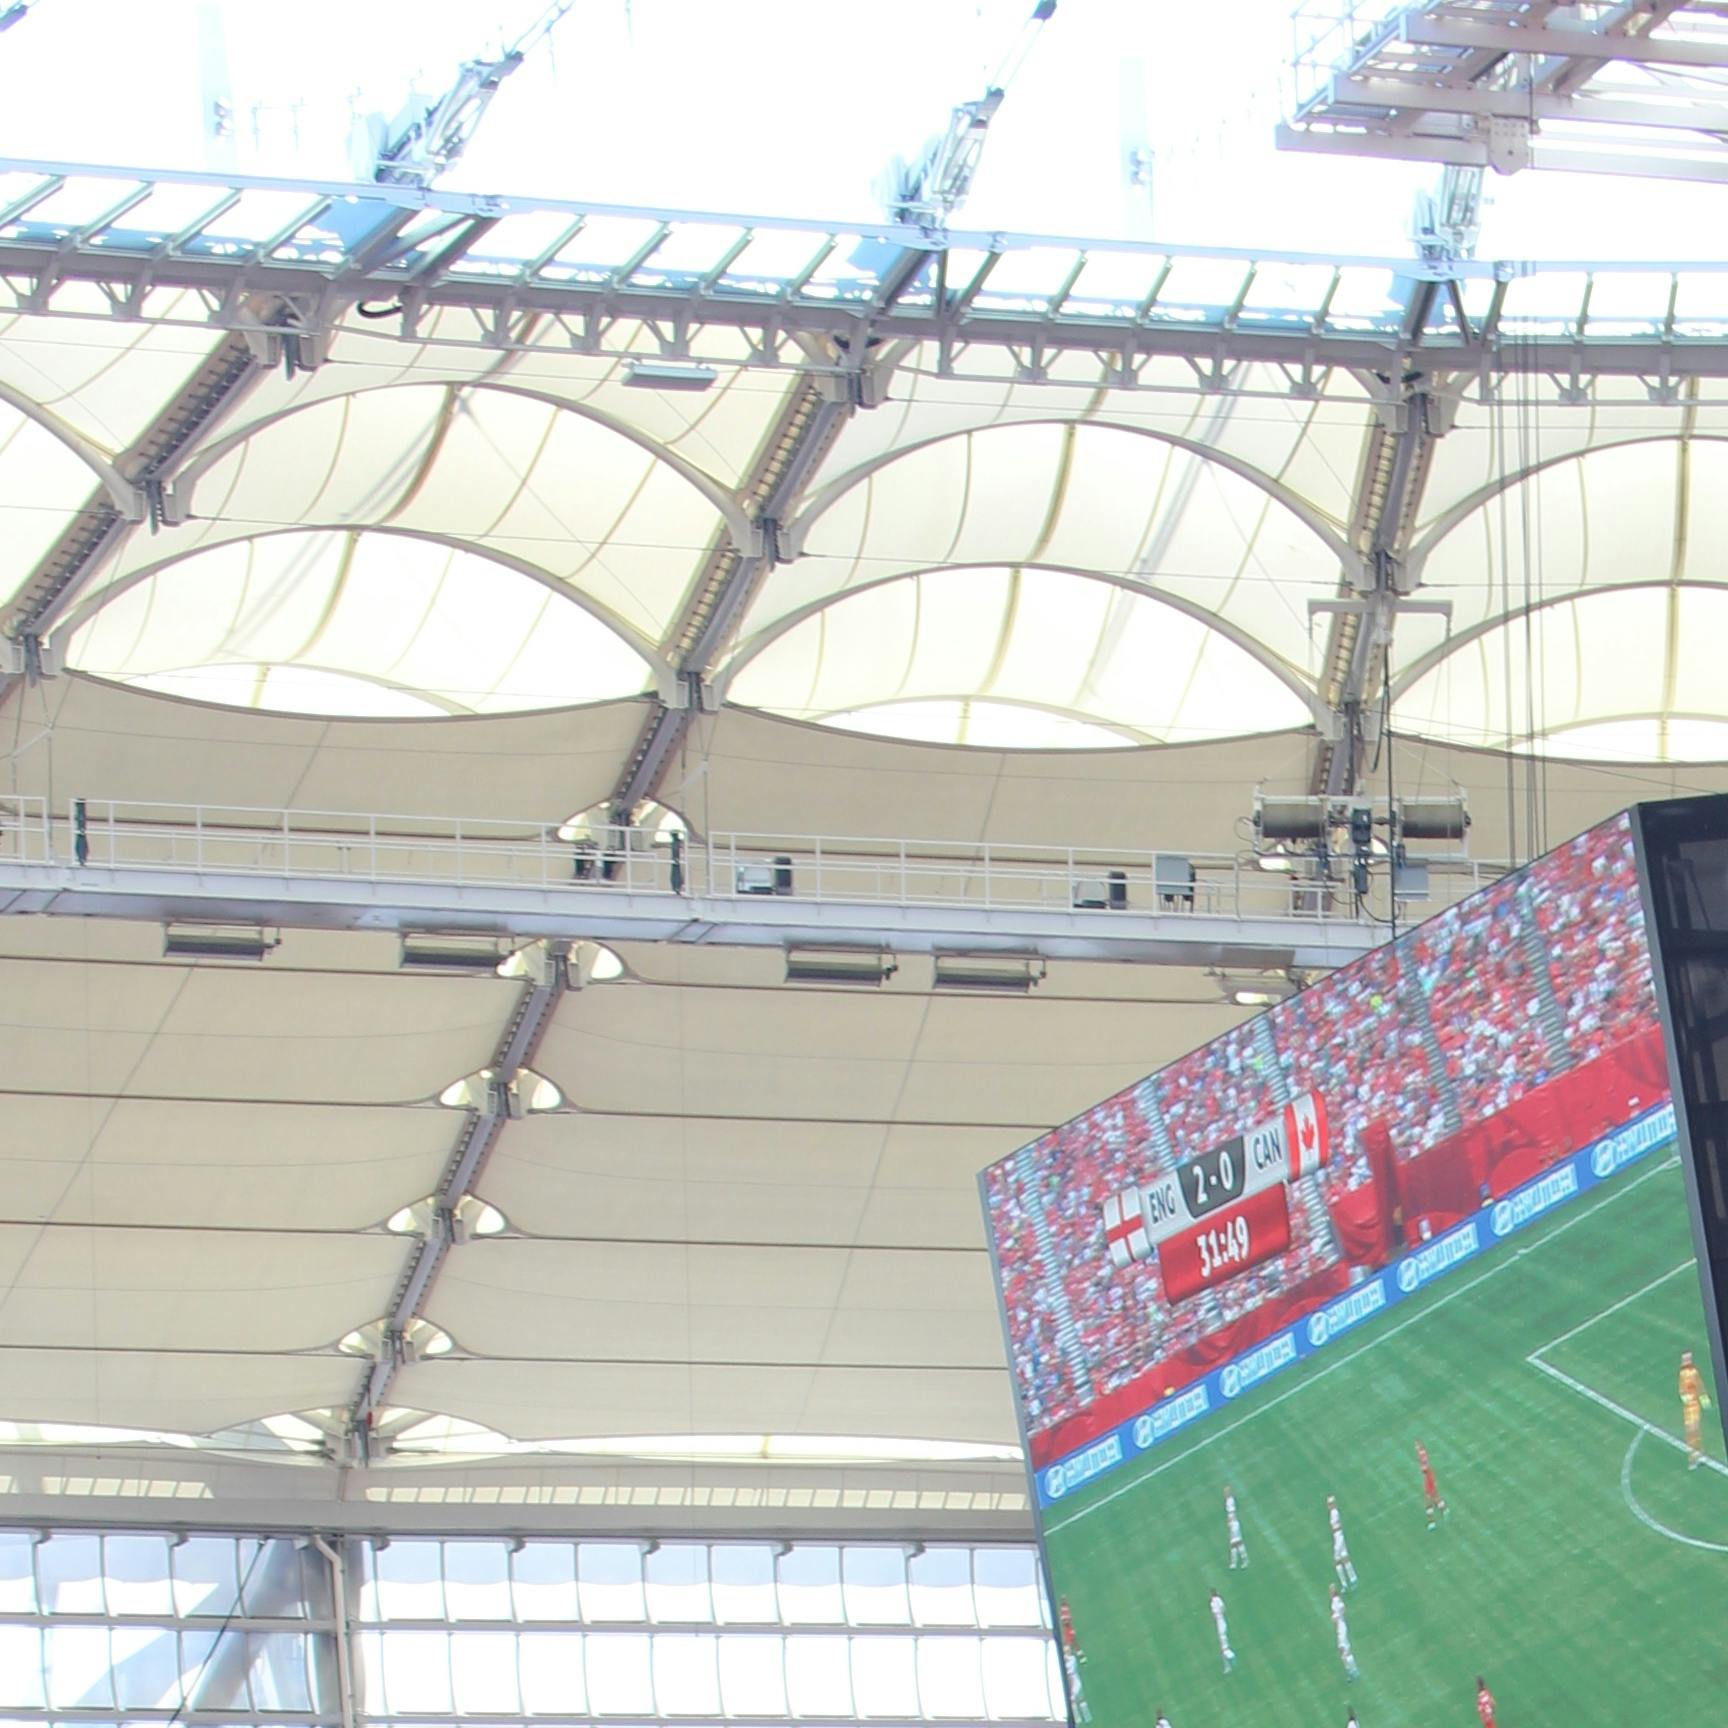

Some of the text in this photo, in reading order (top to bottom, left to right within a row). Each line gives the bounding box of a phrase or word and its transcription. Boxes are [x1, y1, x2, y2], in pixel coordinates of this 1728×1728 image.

[1149, 1183, 1176, 1224] ENG
[1252, 1127, 1283, 1170] CAN
[1196, 1215, 1249, 1278] 31:49
